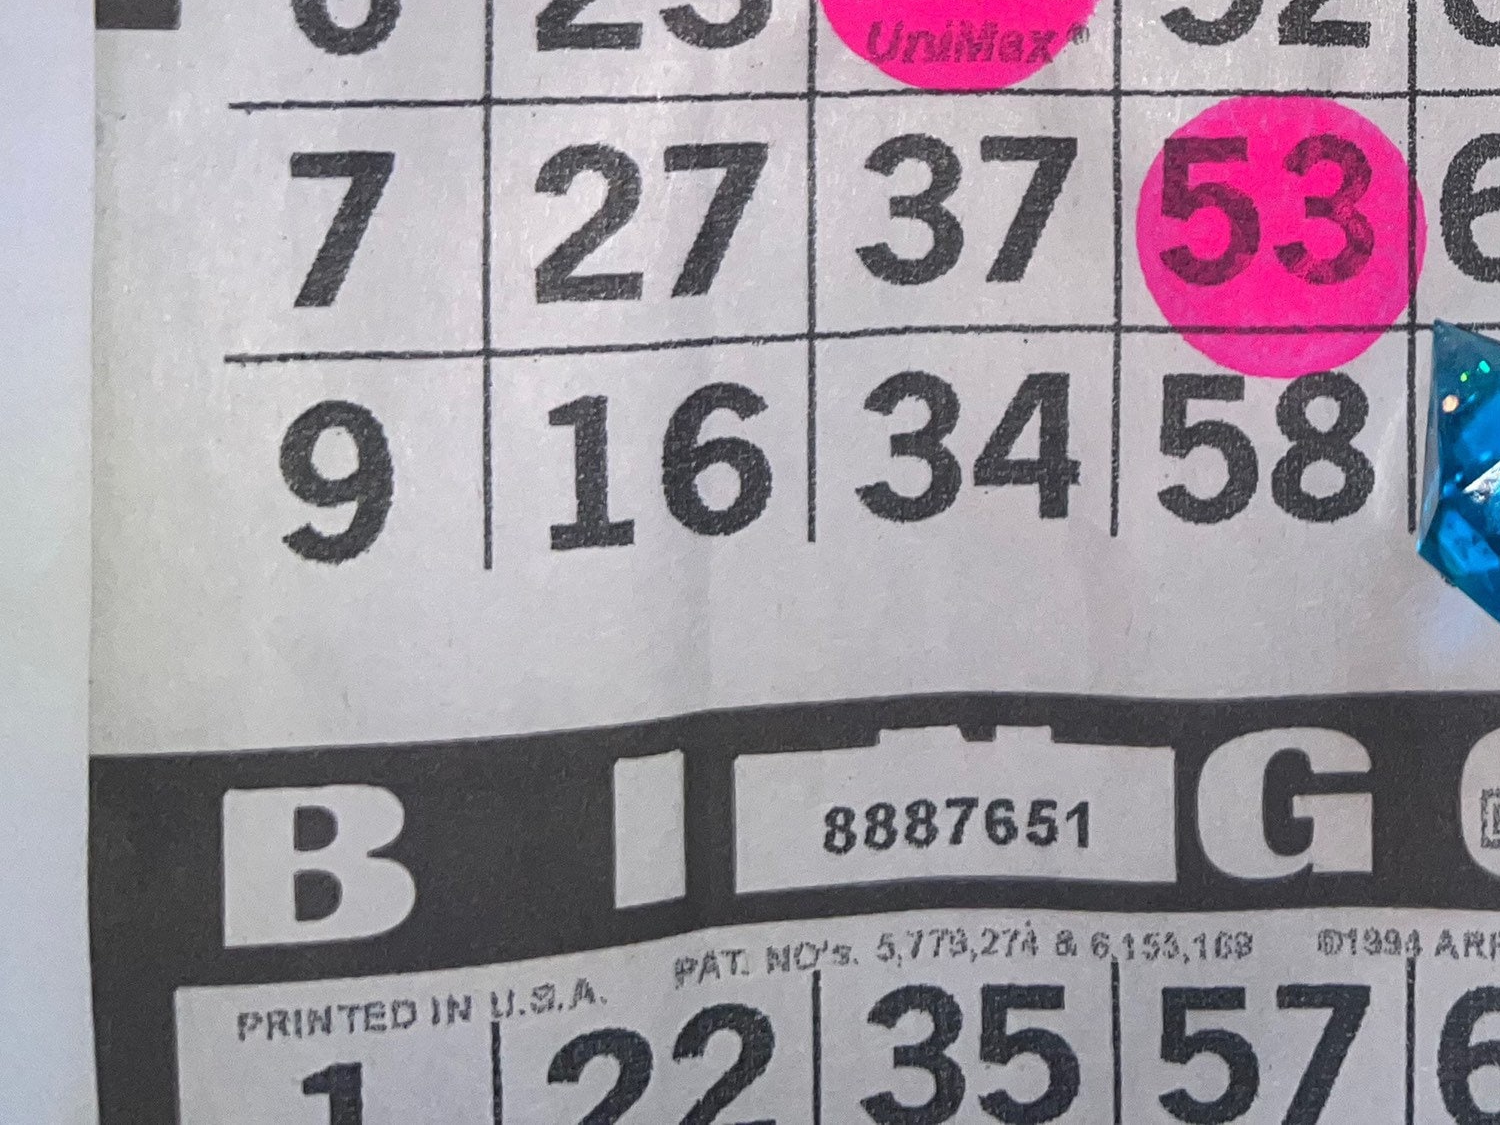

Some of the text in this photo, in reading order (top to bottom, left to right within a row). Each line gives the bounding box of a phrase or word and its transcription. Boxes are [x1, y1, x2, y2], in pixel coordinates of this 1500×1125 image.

[290, 151, 395, 307] 7
[535, 142, 768, 303] 27
[856, 134, 1077, 286] 37
[1160, 134, 1374, 286] 53
[280, 401, 393, 564] 9
[549, 383, 772, 550] 16
[856, 371, 1080, 523] 34
[1158, 372, 1374, 524] 58
[222, 783, 417, 949] B
[824, 798, 1088, 855] 8887651
[1197, 727, 1374, 879] G
[238, 1001, 416, 1041] PRINTED
[432, 996, 471, 1025] IN
[675, 950, 748, 989] PAT.
[1056, 931, 1077, 956] &
[860, 984, 1080, 1125] 35
[1159, 984, 1370, 1125] 57
